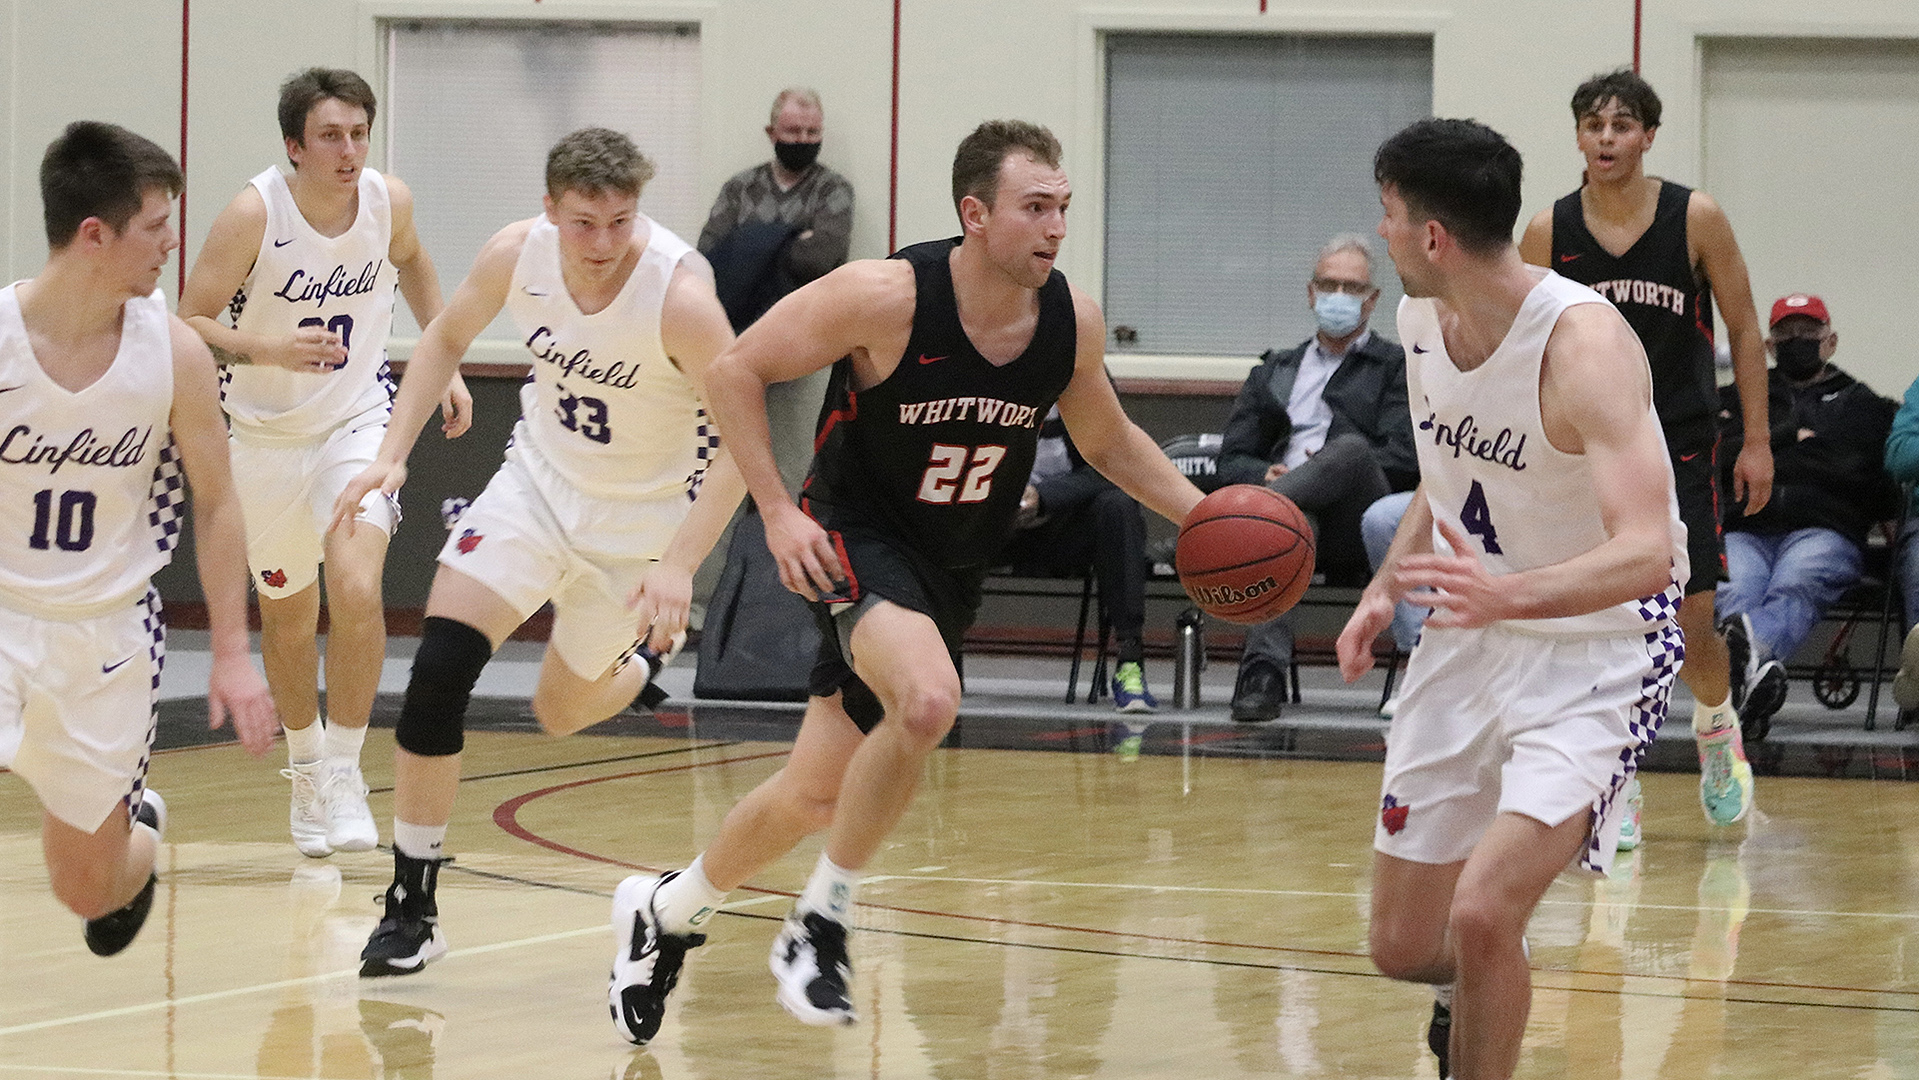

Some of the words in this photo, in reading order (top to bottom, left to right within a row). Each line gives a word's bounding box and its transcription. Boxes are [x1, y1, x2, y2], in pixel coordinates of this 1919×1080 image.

[273, 259, 384, 308] Linfield
[1589, 279, 1685, 316] TWORTH
[526, 326, 641, 389] Linfield
[0, 424, 153, 475] Linfield
[1419, 395, 1527, 471] nfield
[916, 442, 1008, 505] 22
[29, 488, 98, 552] 10
[1460, 478, 1504, 556] 4
[1192, 576, 1280, 606] Wilson
